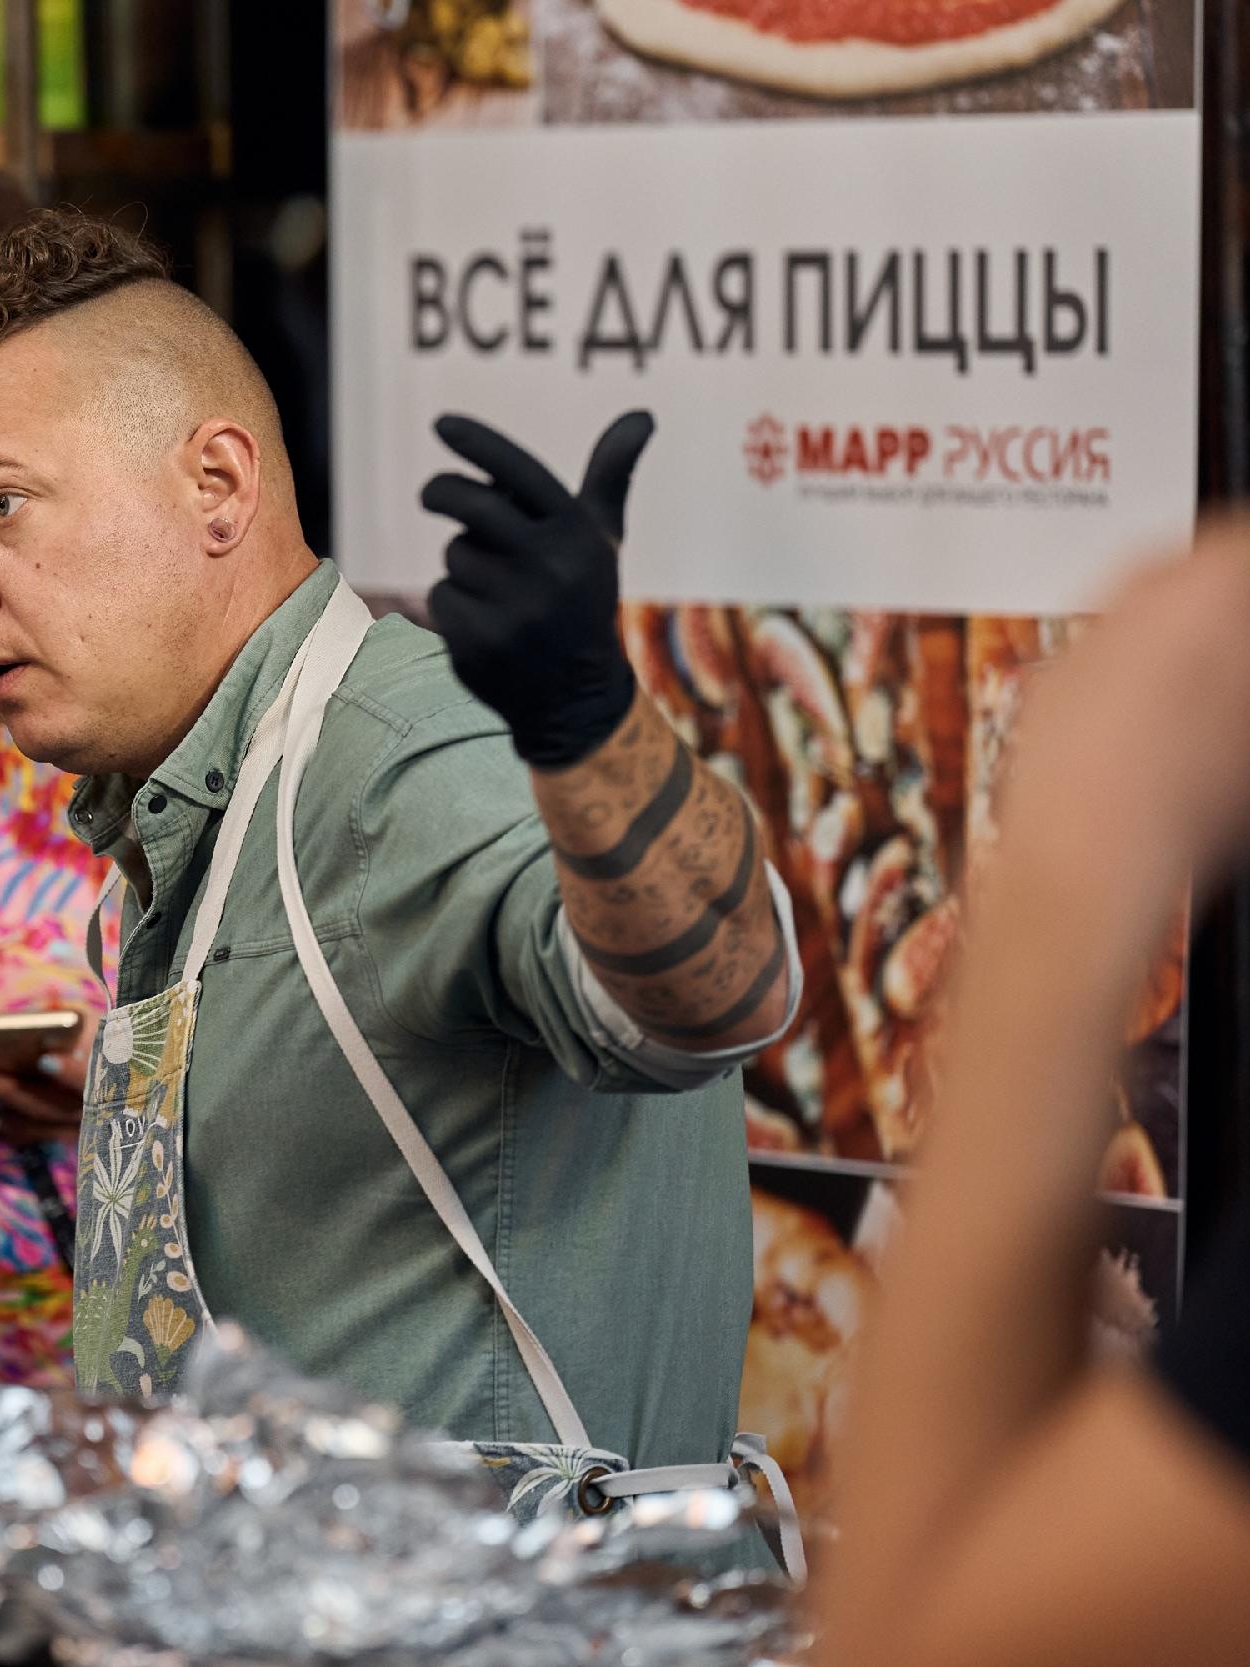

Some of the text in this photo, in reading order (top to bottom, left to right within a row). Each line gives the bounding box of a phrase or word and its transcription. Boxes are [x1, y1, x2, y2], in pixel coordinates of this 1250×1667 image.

[408, 228, 1110, 377] ВСЁ ДЛЯ ПИЦЦЫ
